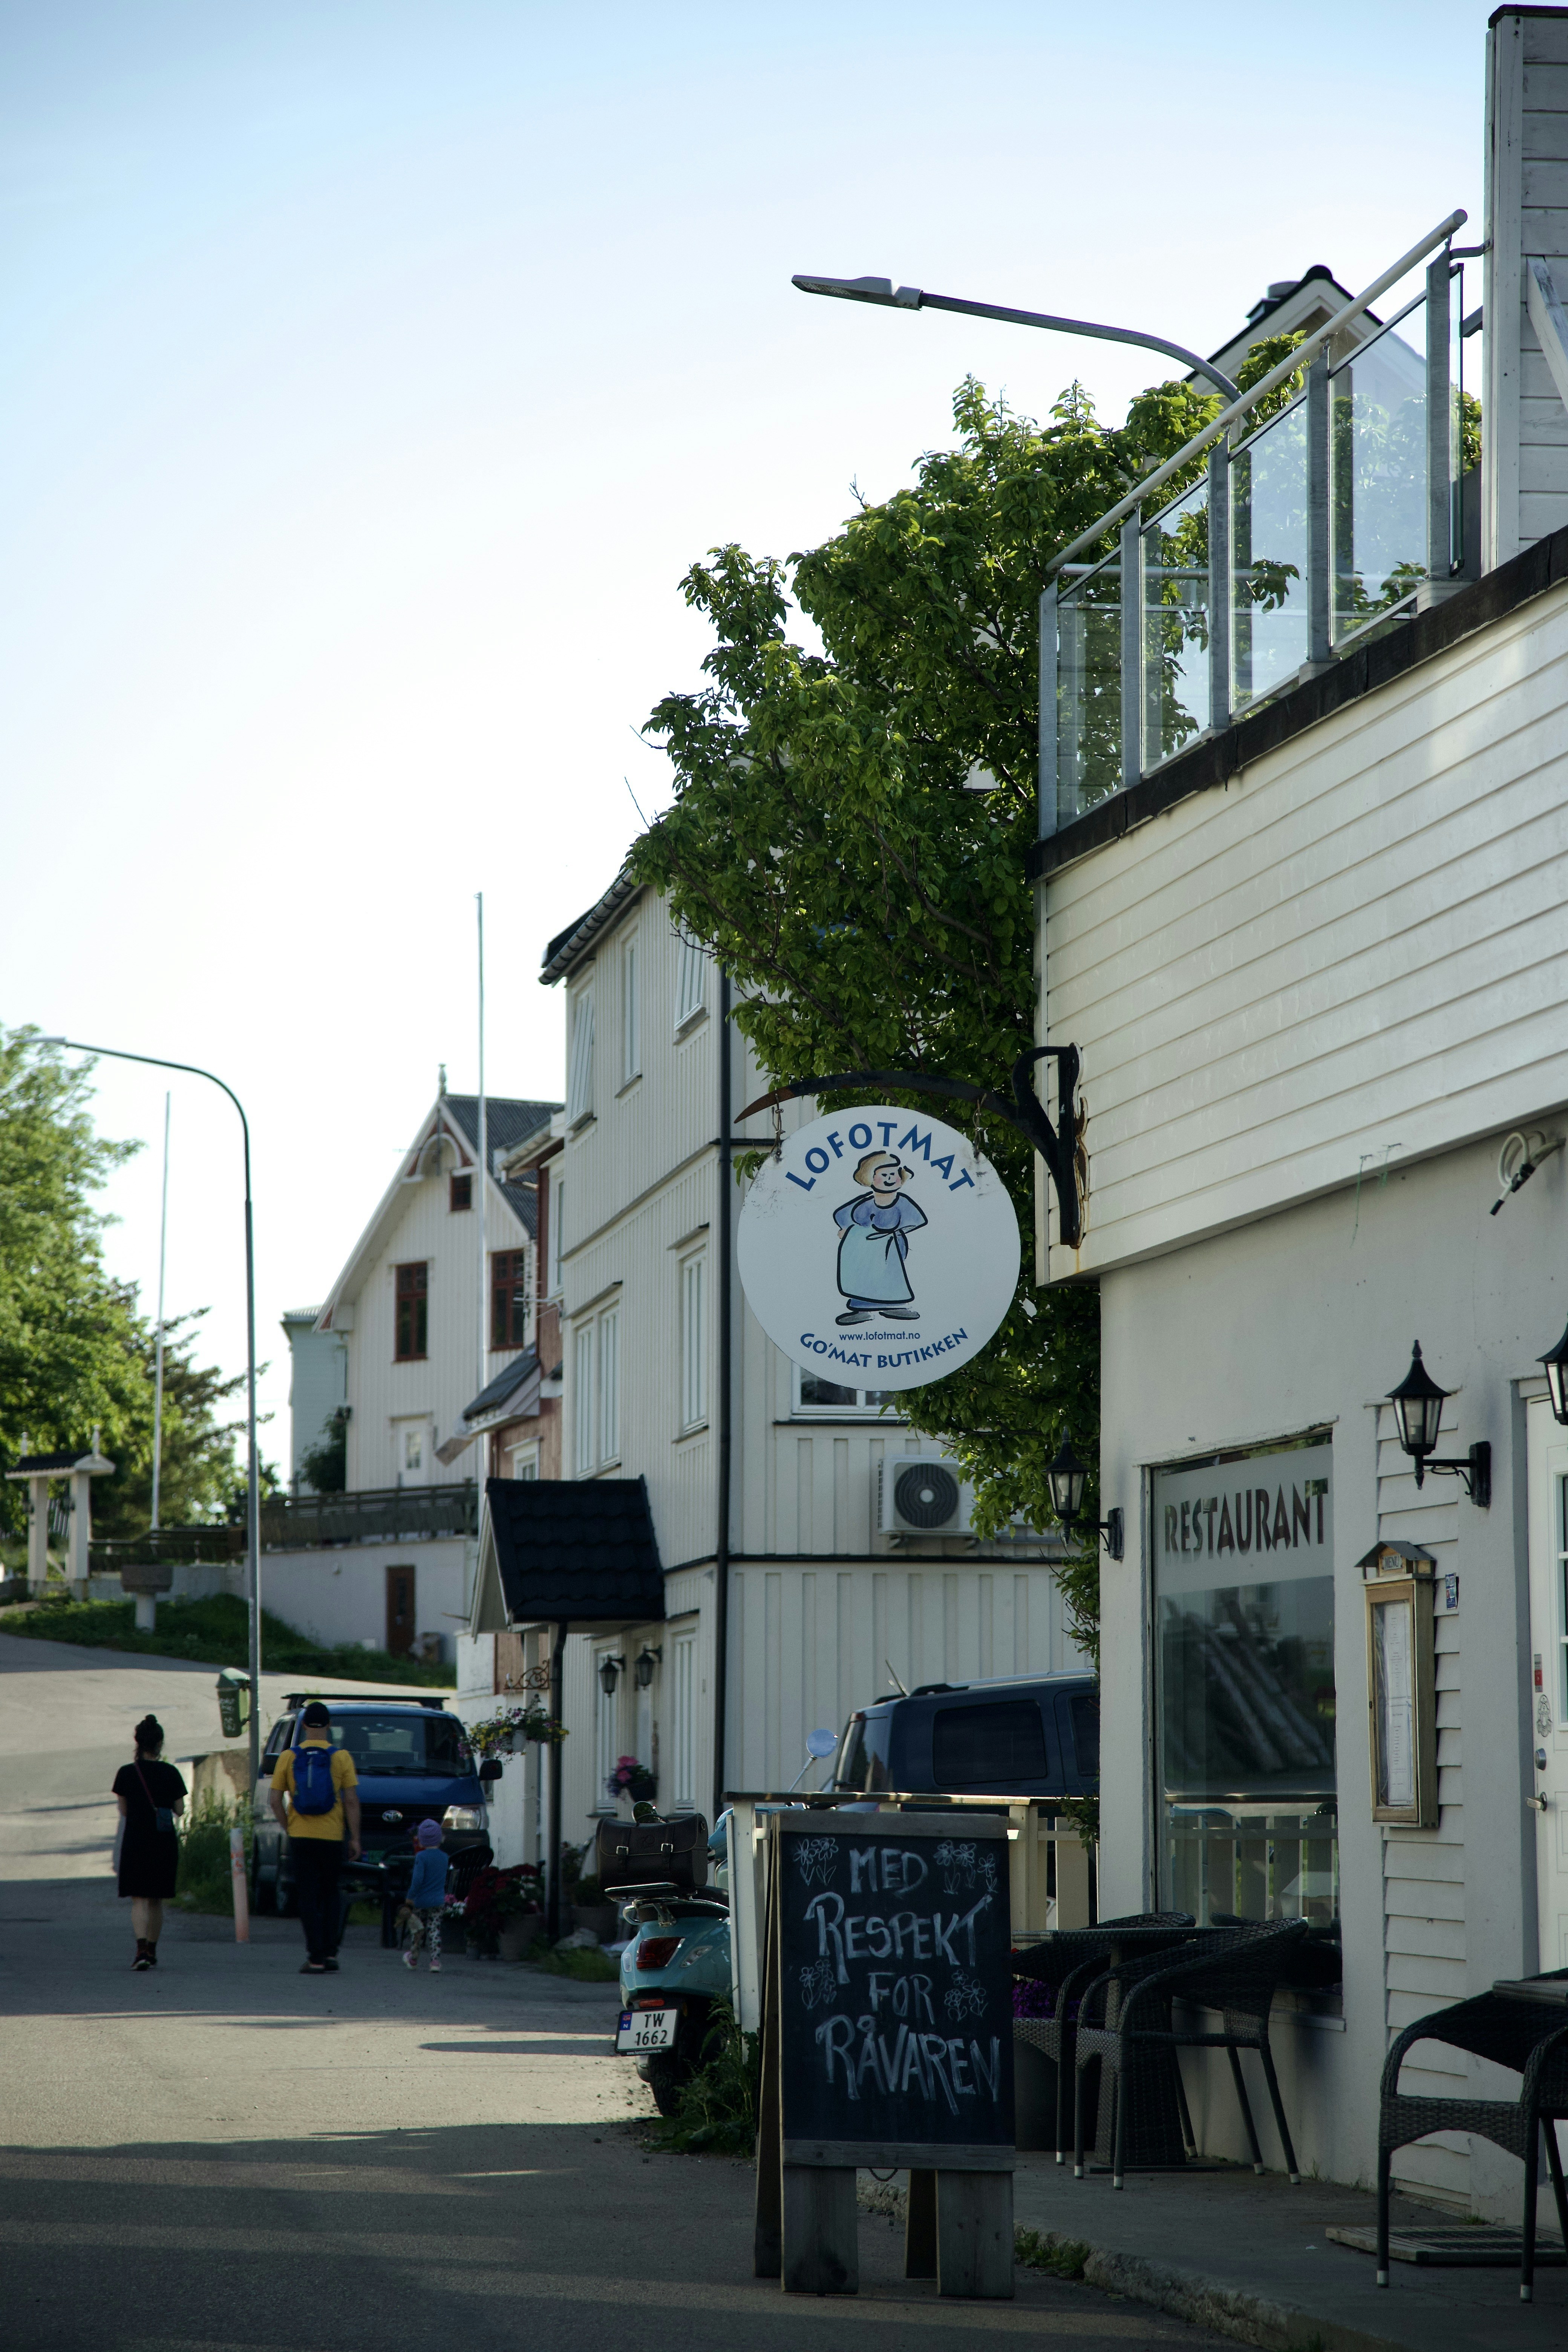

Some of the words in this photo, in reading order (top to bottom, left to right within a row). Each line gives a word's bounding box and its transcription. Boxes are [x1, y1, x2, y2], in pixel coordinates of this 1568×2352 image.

[786, 1121, 975, 1192] LOFOTMAT
[839, 1332, 920, 1341] www.lofotmat.no
[877, 1328, 968, 1368] BUTIKKEN
[1164, 1478, 1328, 1564] RESTAURANT
[1384, 1556, 1399, 1568] MENU
[849, 1846, 929, 1894] MED
[803, 1891, 993, 1984] RESPEKT
[645, 2013, 665, 2028] TW
[866, 1972, 936, 2025] FOR
[635, 2030, 667, 2046] 1662
[815, 2014, 1001, 2116] RÅVAREN
